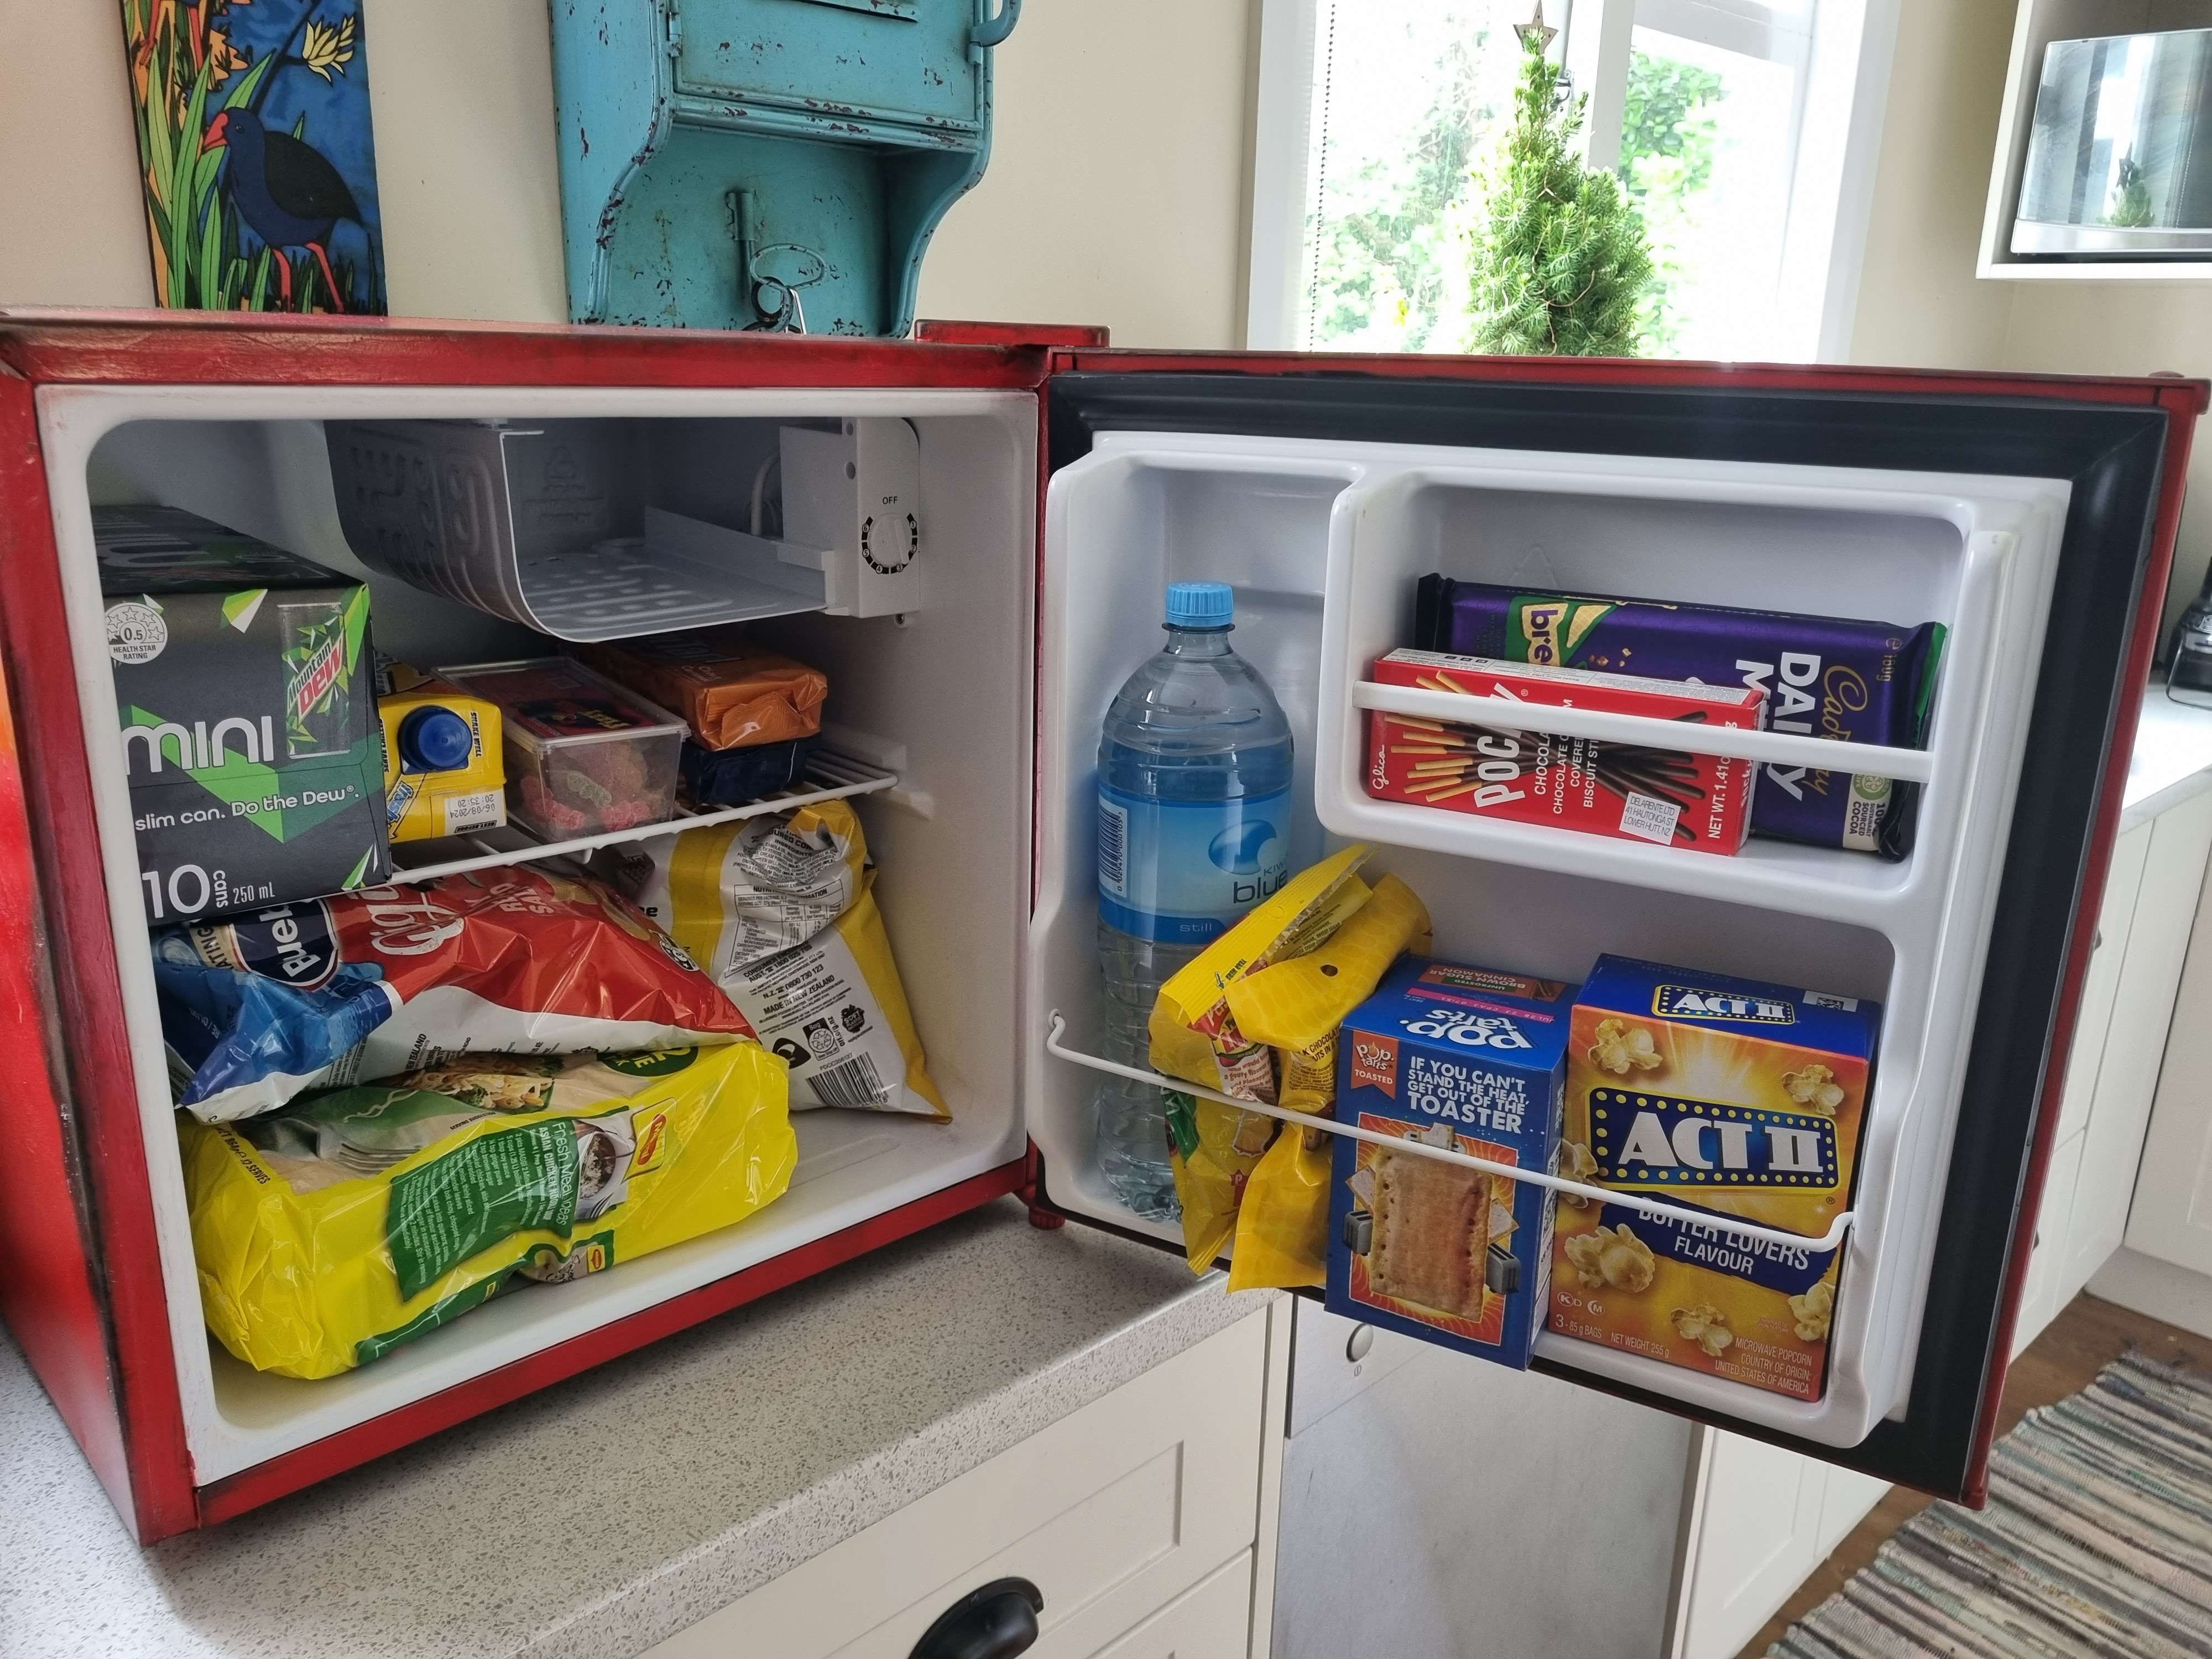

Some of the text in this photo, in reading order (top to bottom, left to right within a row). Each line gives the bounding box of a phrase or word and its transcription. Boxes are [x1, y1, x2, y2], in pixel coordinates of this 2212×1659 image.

[882, 496, 898, 504] OFF
[124, 627, 143, 641] 0.5
[1765, 651, 1822, 802] DAIY
[473, 737, 482, 757] WELL
[1372, 744, 1389, 790] Glico
[1553, 744, 1568, 815] CHOCOLATE
[1583, 763, 1597, 808] BISCUIT
[135, 813, 175, 831] slim
[180, 808, 226, 823] can.
[231, 800, 259, 817] Do
[262, 795, 298, 812] the
[1663, 803, 1676, 816] LTD
[1711, 793, 1726, 814] WT.
[1623, 815, 1646, 829] LOWER
[1660, 827, 1672, 837] NZ
[1666, 816, 1675, 828] ST
[1708, 815, 1723, 839] NET
[1849, 801, 1861, 835] COCOA
[1858, 802, 1870, 837] SOURCED
[1866, 802, 1875, 838] SUSTAINABLY
[142, 864, 211, 919] 10
[213, 870, 228, 909] cans
[233, 881, 275, 905] 250 mL
[1233, 869, 1288, 905] blue
[1180, 922, 1213, 933] still
[743, 952, 779, 978] CONSUMER
[749, 972, 767, 983] AUST.
[774, 957, 789, 968] 1800
[1442, 968, 1516, 983] CINNAMON
[763, 963, 825, 999] N.Z. 0800 730 123
[1428, 969, 1527, 989] BROWN SUGAR
[1454, 978, 1505, 991] UNFROSTED
[763, 1000, 785, 1015] MADE
[785, 996, 793, 1007] IN
[808, 974, 836, 994] ZEALAND
[1673, 993, 1786, 1019] ACT II
[808, 1022, 821, 1031] Bag
[1425, 1009, 1518, 1031] tarts
[410, 1032, 427, 1062] ZEALAND
[1324, 1044, 1332, 1054] IN
[1354, 1068, 1394, 1084] TOASTED
[1361, 1056, 1389, 1071] tarts
[1410, 1055, 1526, 1093] IF YOU CAN'T
[1407, 1069, 1530, 1107] STAND THE HEAT,
[1407, 1079, 1526, 1116] GET OUT OF THE
[450, 1119, 469, 1130] SERVING
[1407, 1090, 1522, 1134] TOASTER
[1618, 1110, 1825, 1174] ACT II
[482, 1154, 491, 1172] brown
[518, 1147, 528, 1165] MAGGI
[538, 1126, 556, 1186] ASIAN CHICKEN
[552, 1121, 570, 1163] Fresh
[561, 1162, 574, 1197] Meal
[246, 1164, 272, 1185] SERVES
[502, 1162, 510, 1179] sauce
[450, 1215, 460, 1237] chopped
[1674, 1235, 1755, 1275] FLAVOUR
[1555, 1313, 1603, 1339] 3 85 g BAGS
[1611, 1332, 1670, 1359] NET WEIGHT 255 g
[1735, 1337, 1812, 1366] MICROWAVE POPCORN
[1715, 1359, 1809, 1395] UNITED STATES OF AMERICA
[1741, 1353, 1812, 1381] COUNTRY OF ORIGIN:
